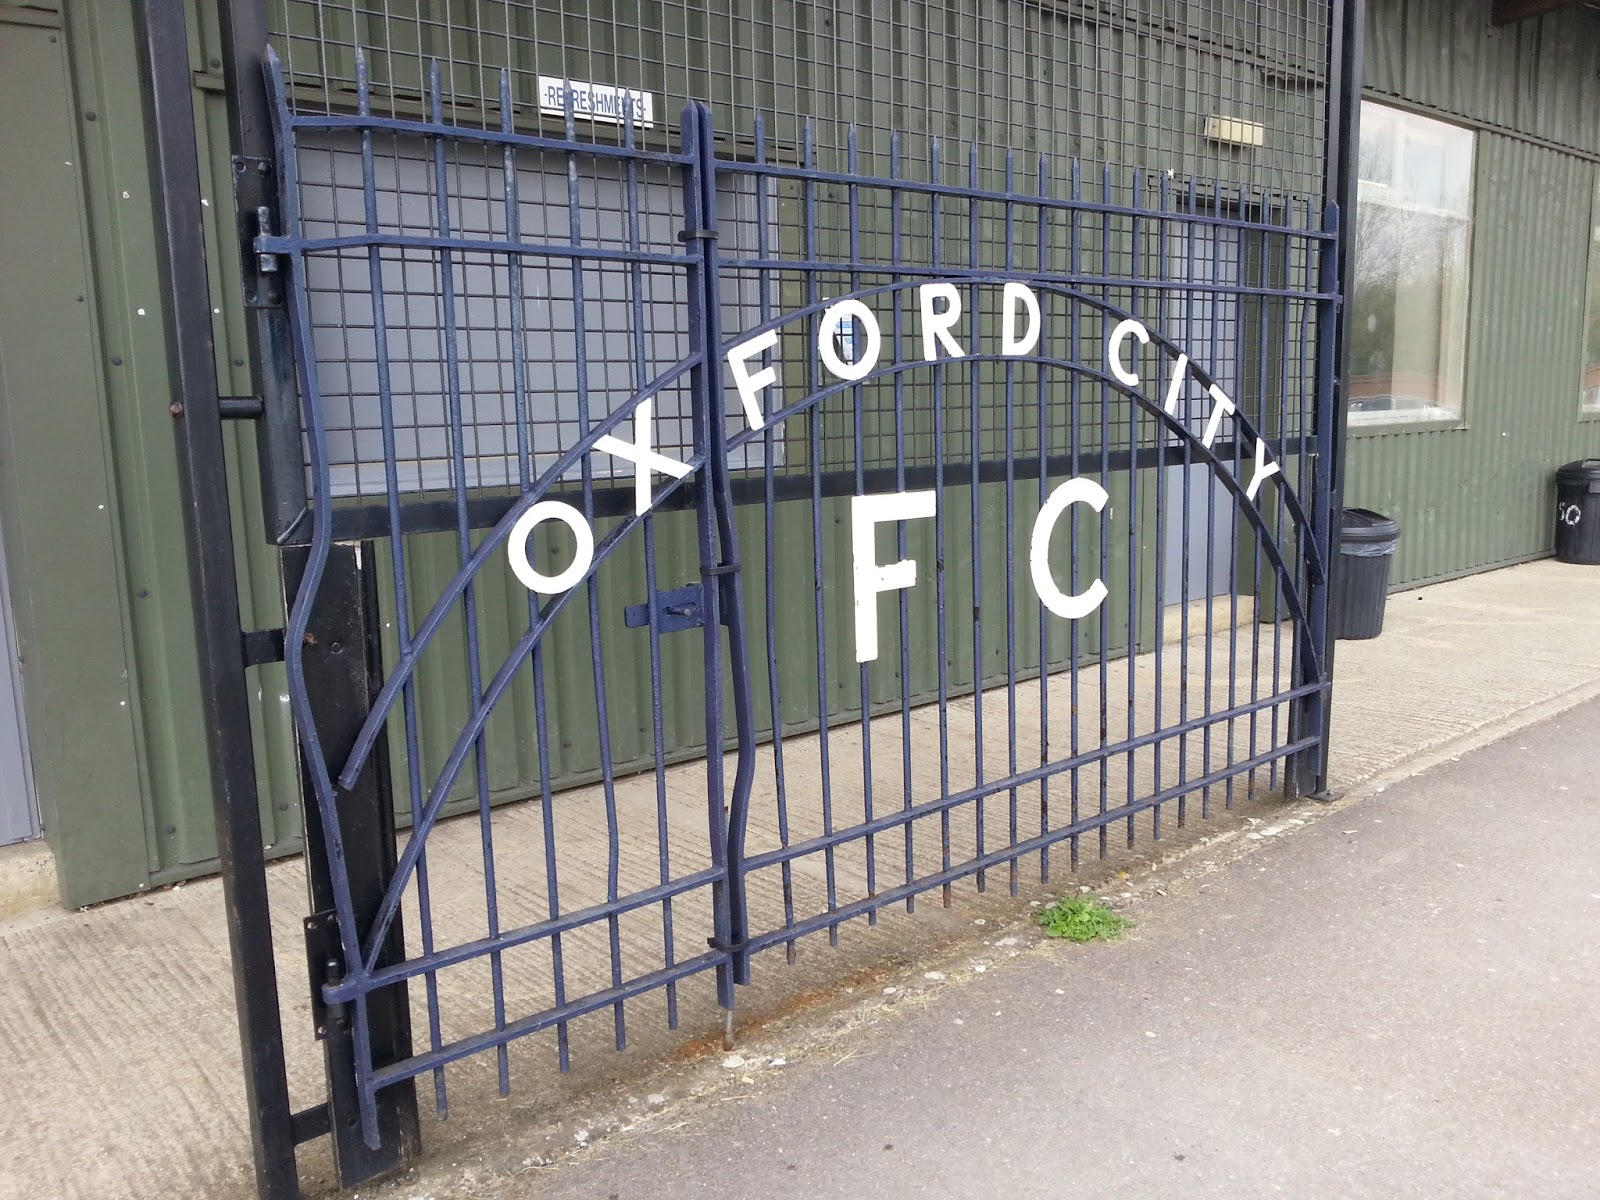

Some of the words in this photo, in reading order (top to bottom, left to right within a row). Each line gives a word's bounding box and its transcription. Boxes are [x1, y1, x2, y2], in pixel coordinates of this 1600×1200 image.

[547, 85, 643, 118] RERESHMES
[508, 282, 1041, 594] OXFORD
[1108, 319, 1280, 501] CITY
